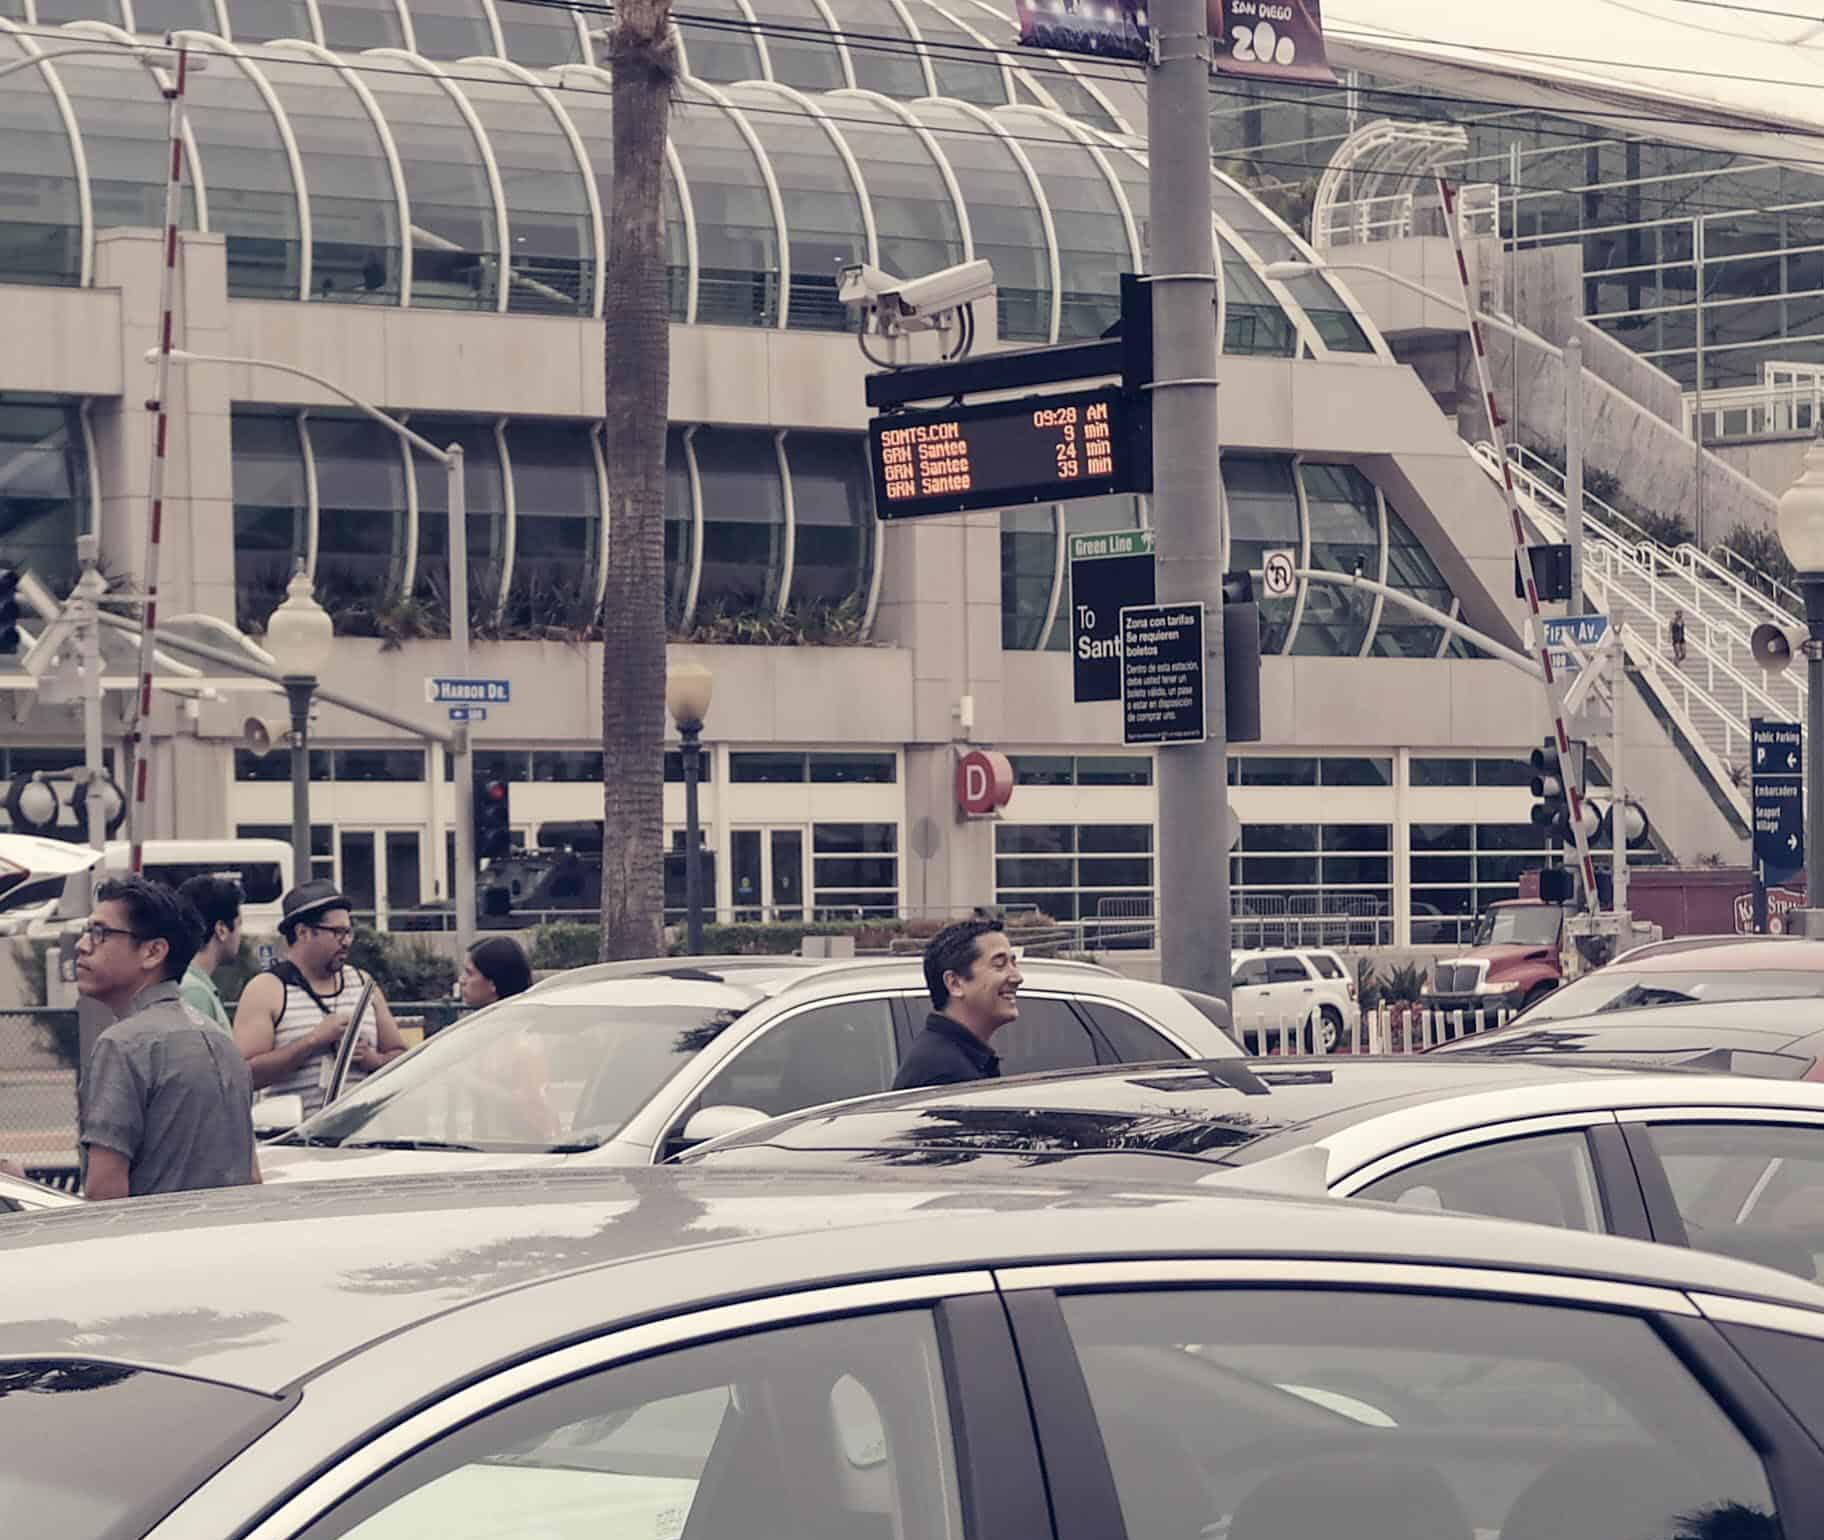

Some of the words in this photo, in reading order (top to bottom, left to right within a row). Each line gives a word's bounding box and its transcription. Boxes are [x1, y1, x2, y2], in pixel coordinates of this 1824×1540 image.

[1232, 0, 1256, 15] SAN
[1259, 3, 1293, 20] DIEGO
[881, 422, 960, 447] SDMTS.COM
[1034, 407, 1077, 428] 09:28
[1087, 403, 1108, 422] AM
[883, 446, 912, 466] GRN
[918, 441, 968, 460] Santee
[1064, 425, 1075, 441] 9
[1084, 423, 1110, 440] min
[885, 464, 914, 482] GRN
[920, 458, 969, 478] Santee
[1056, 444, 1077, 461] 24
[1086, 440, 1111, 457] min
[887, 482, 916, 499] GRN
[922, 475, 971, 494] Santee
[1058, 461, 1078, 479] 39
[1088, 457, 1113, 475] min
[1076, 539, 1107, 556] Green
[1109, 536, 1133, 553] Line
[1077, 605, 1096, 629] To
[1126, 617, 1148, 629] Zona
[1149, 618, 1166, 627] con
[1167, 614, 1195, 626] tarifas
[1126, 631, 1137, 643] Se
[1139, 630, 1180, 644] requieren
[1544, 623, 1576, 642] FIF
[1579, 622, 1599, 641] AV.
[1078, 635, 1121, 659] Sant
[1126, 645, 1158, 657] boletos
[441, 682, 485, 699] HARBOR
[488, 683, 509, 700] DR.
[1754, 731, 1775, 743] Public
[1776, 731, 1800, 746] Parking
[1757, 747, 1766, 765] P
[967, 764, 987, 800] D
